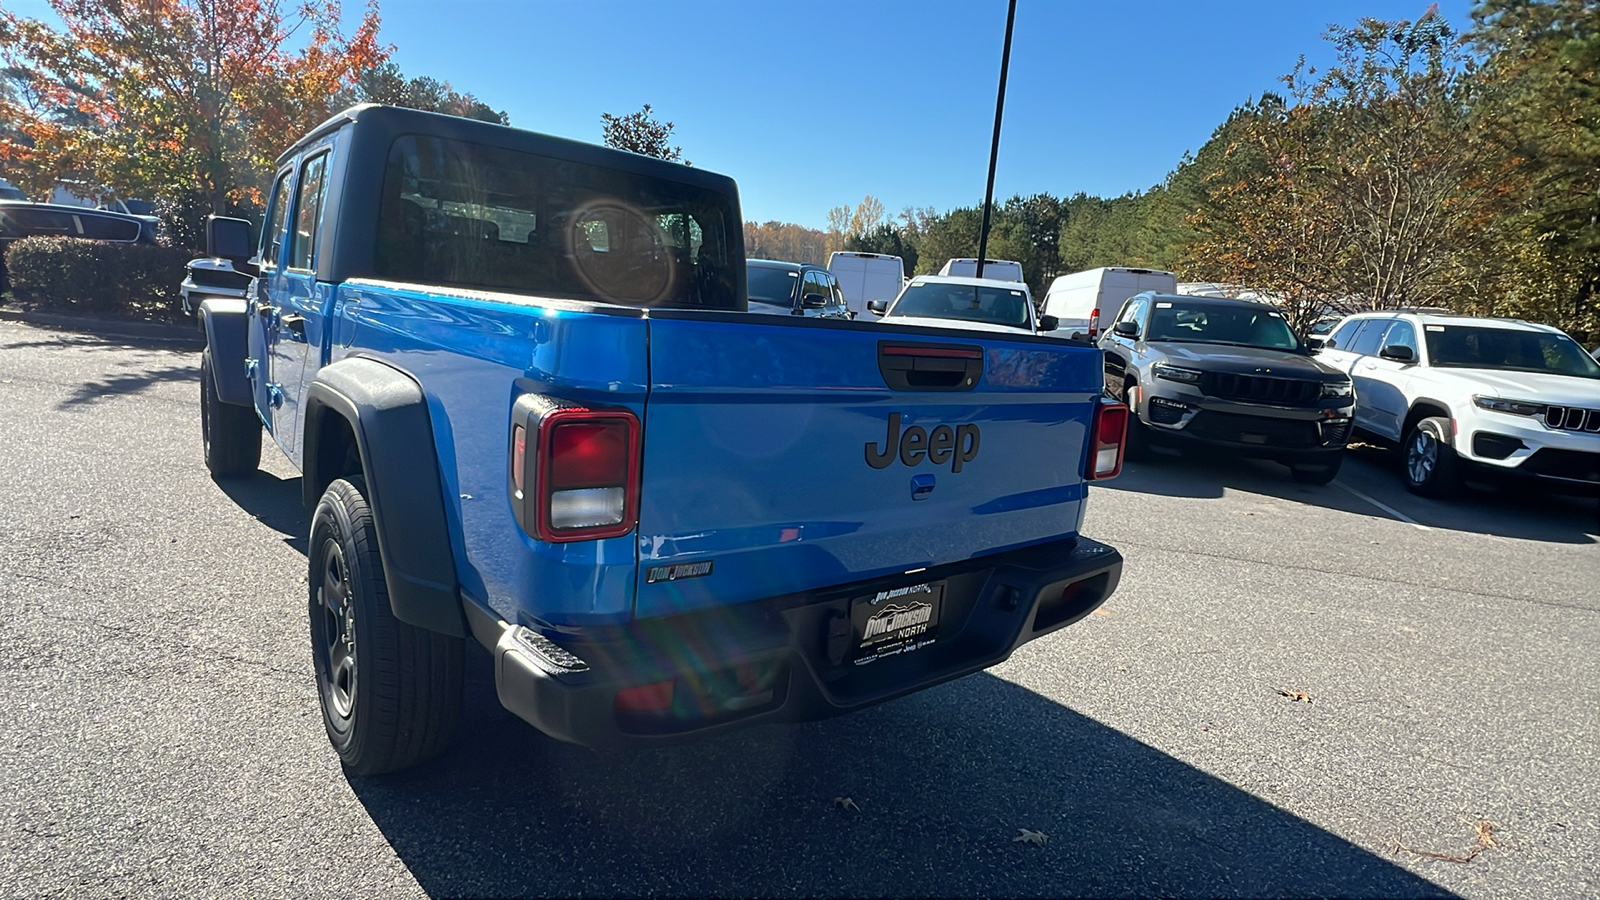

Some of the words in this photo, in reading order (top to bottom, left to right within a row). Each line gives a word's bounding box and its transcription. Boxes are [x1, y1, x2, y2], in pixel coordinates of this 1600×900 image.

[865, 412, 980, 473] Jeep
[862, 618, 888, 640] DON
[886, 607, 932, 632] JACKSON
[898, 624, 928, 640] NORTH
